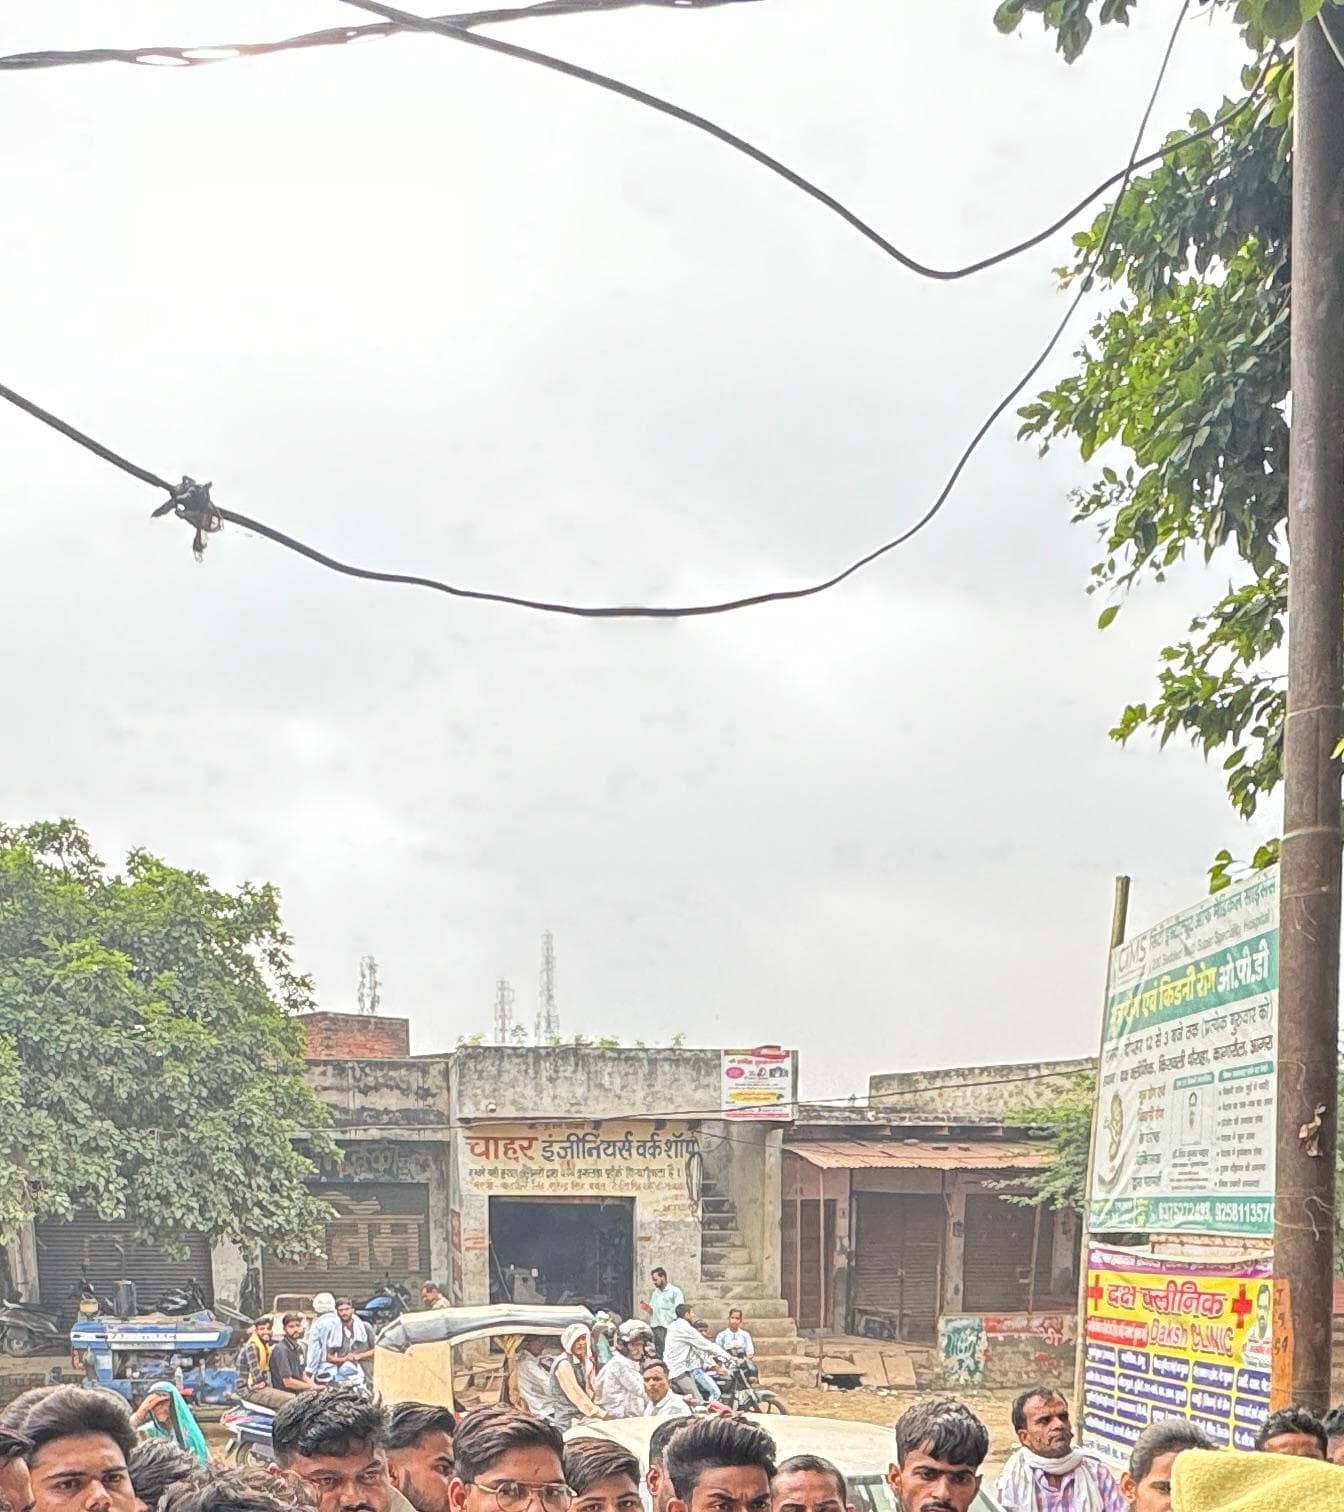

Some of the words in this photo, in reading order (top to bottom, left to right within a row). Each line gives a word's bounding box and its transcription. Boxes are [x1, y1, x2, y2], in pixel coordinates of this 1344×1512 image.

[1158, 964, 1195, 1010] किडनी
[463, 1136, 539, 1162] चाहर
[1140, 1280, 1227, 1318] क्लीनिक
[1150, 1318, 1188, 1349] Daksh
[1191, 1323, 1234, 1356] CLINIC
